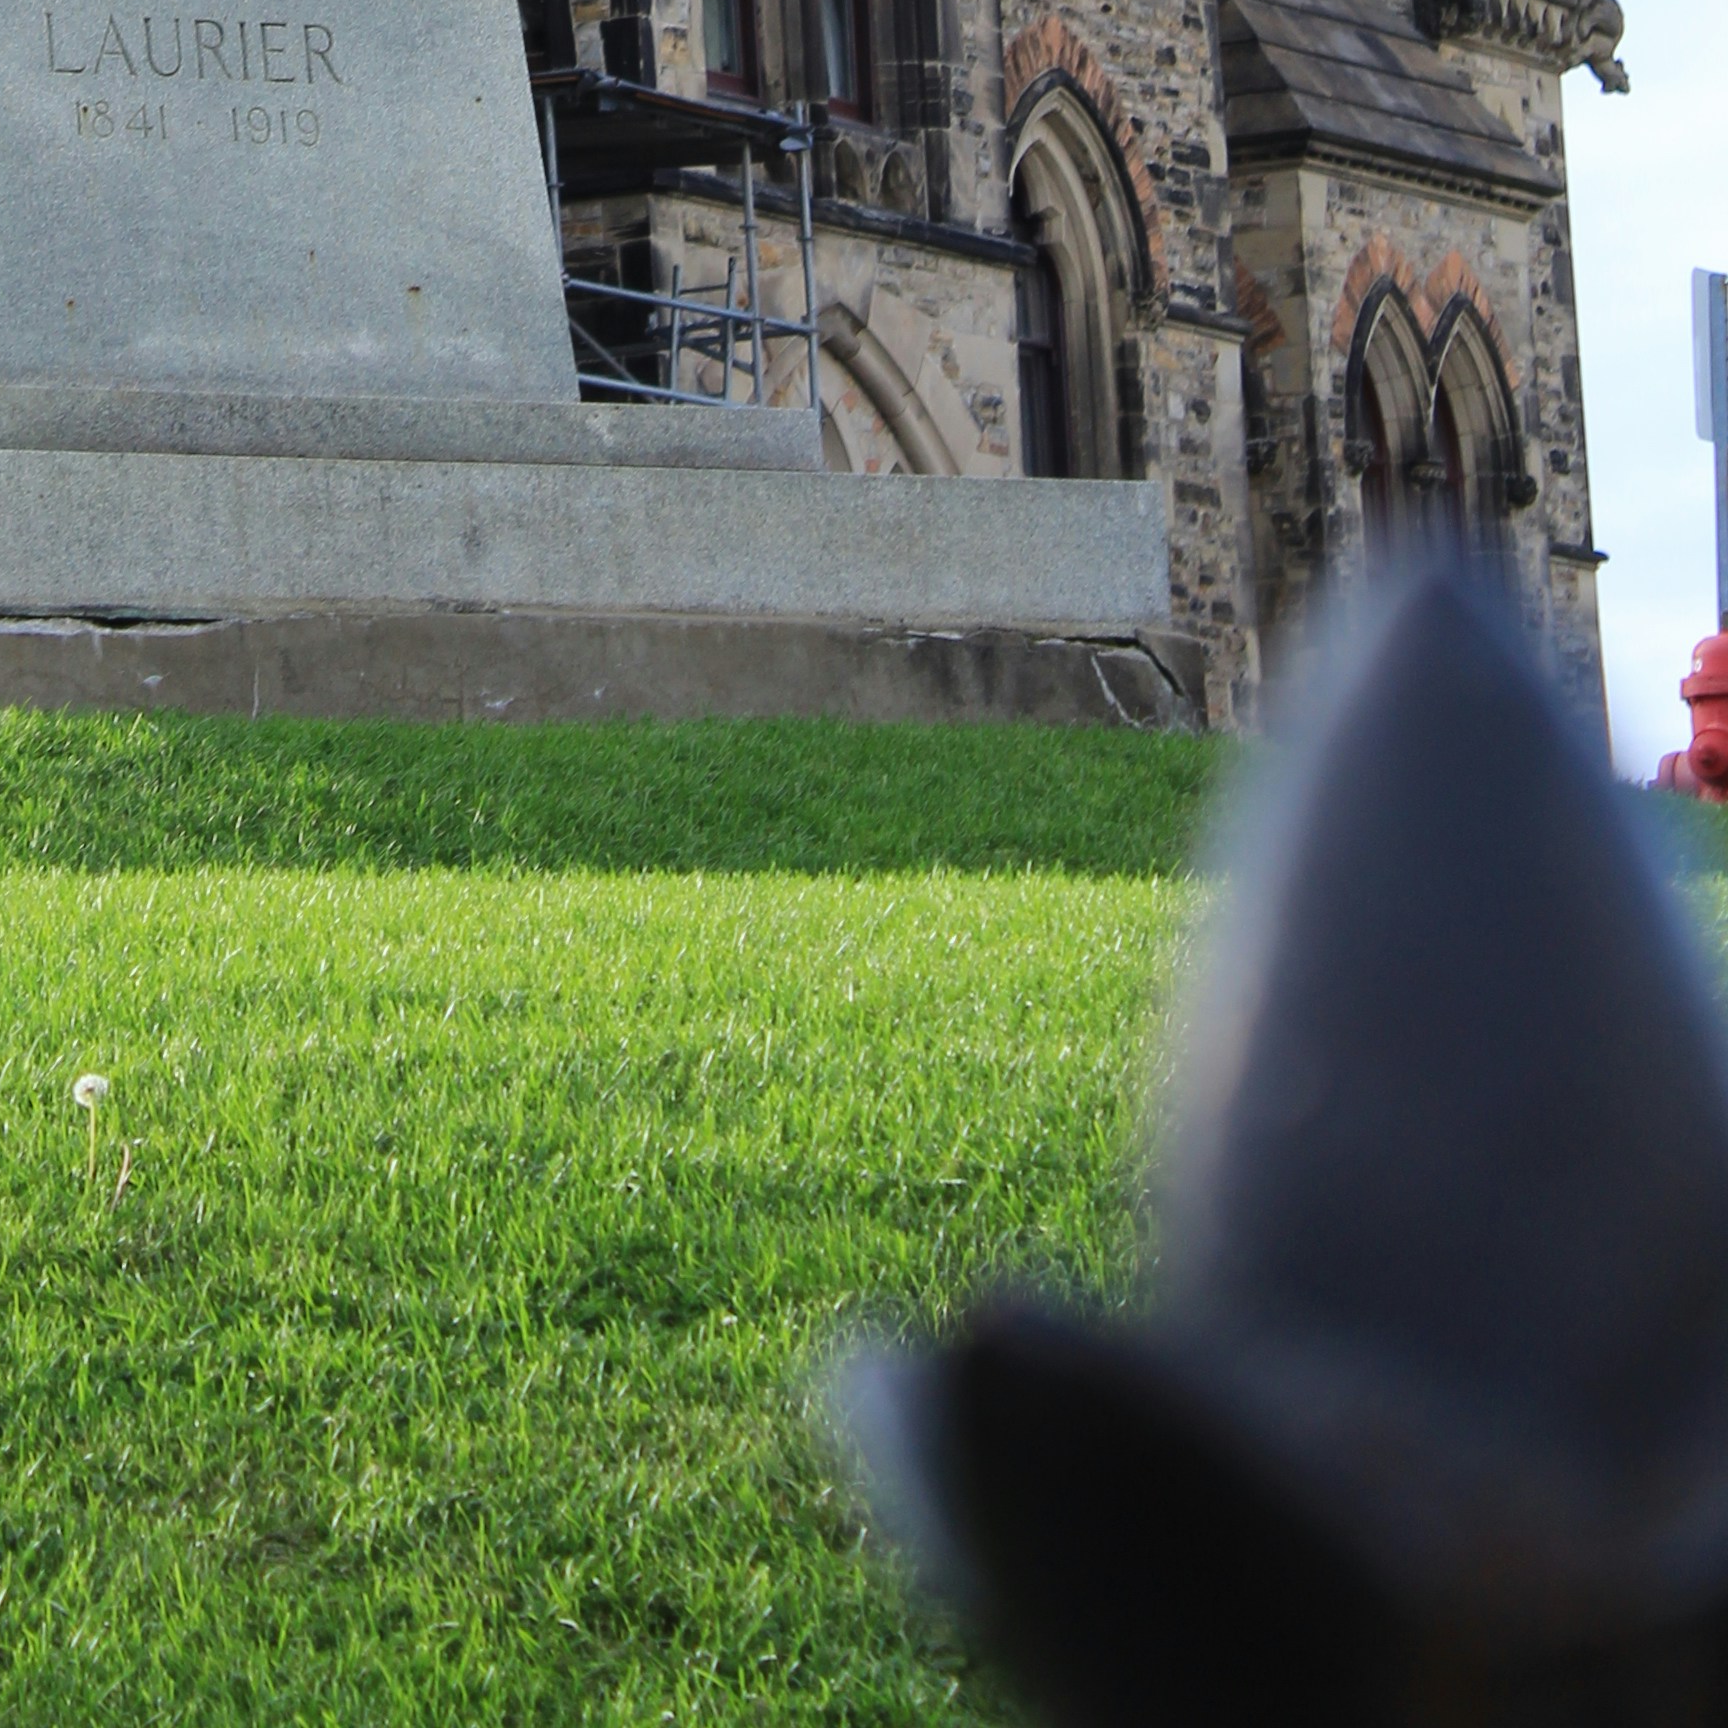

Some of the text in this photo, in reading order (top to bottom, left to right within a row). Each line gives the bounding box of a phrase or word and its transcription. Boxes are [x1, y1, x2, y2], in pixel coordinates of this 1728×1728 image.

[44, 11, 343, 84] LAURIER
[75, 99, 322, 148] 1841 1919
